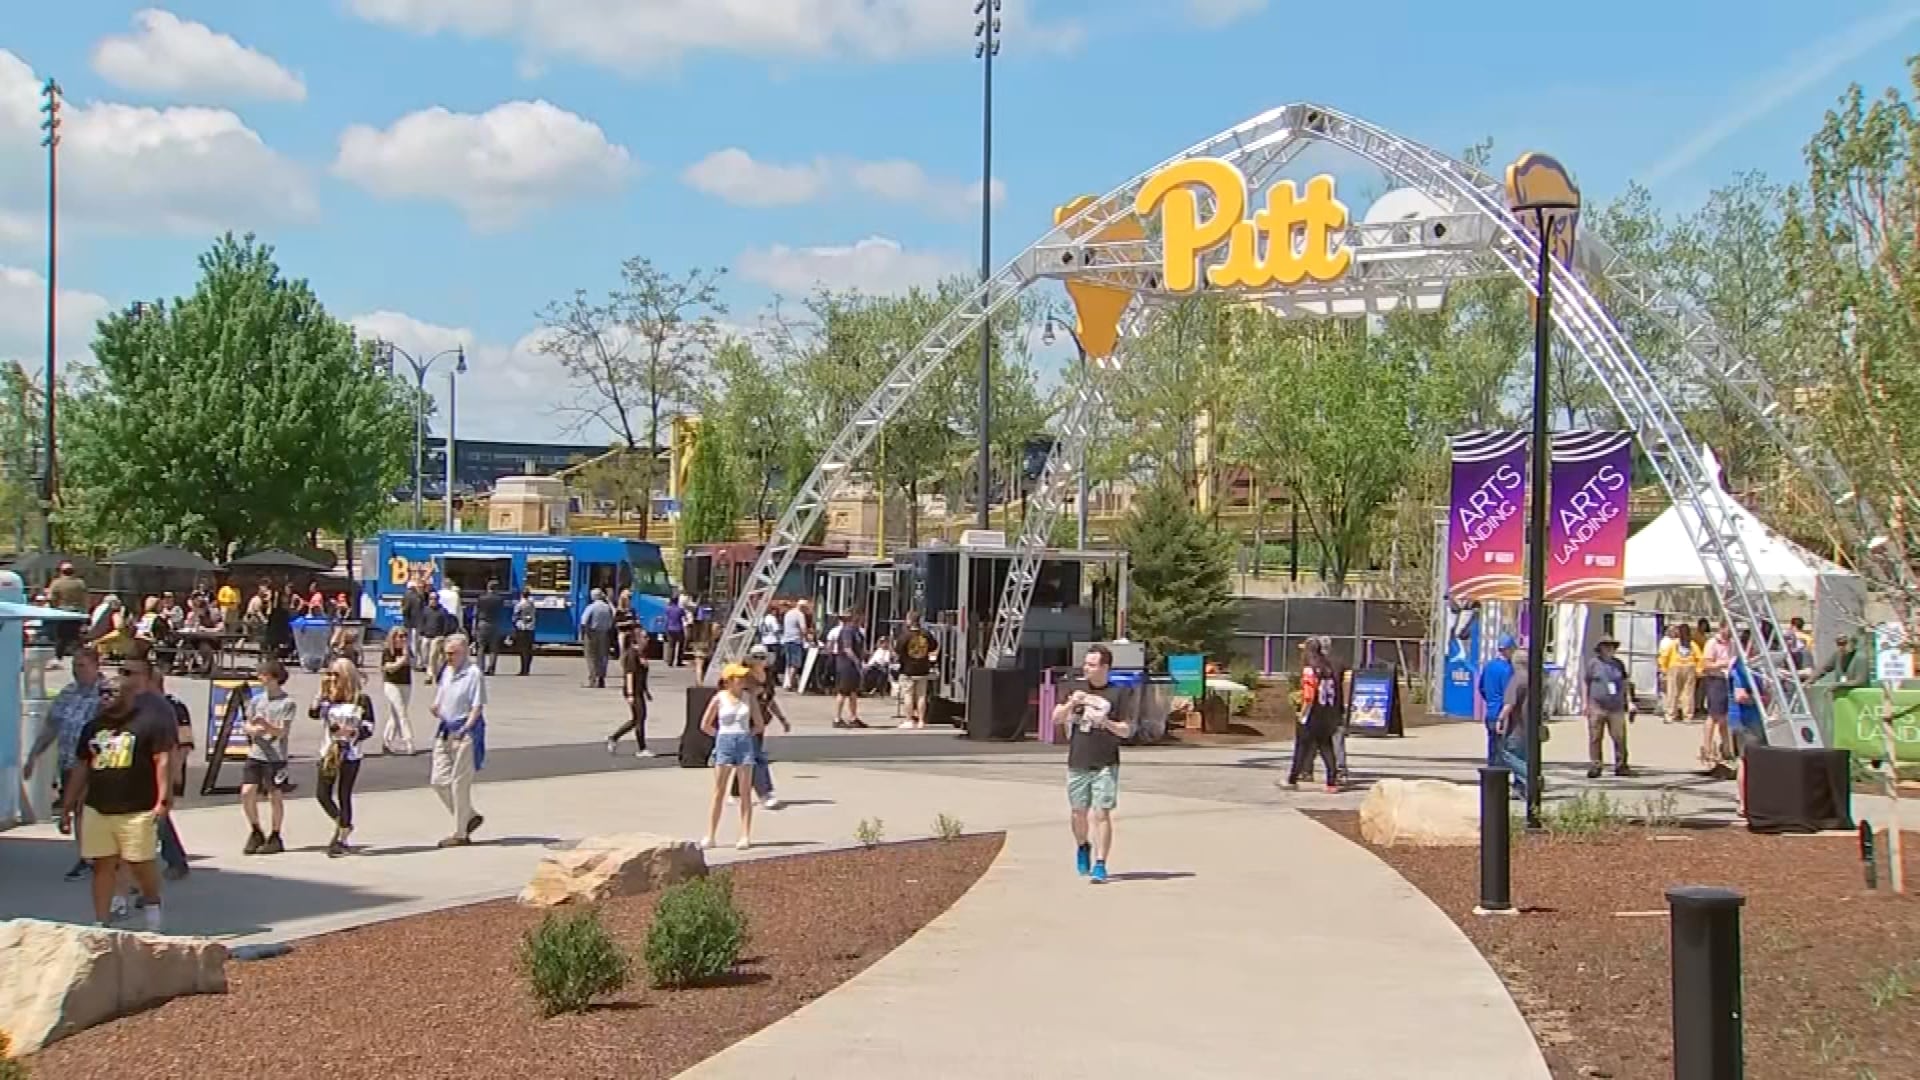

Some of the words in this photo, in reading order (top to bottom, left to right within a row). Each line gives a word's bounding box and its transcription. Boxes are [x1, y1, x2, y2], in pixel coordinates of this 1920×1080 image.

[1135, 157, 1354, 292] Pitt
[1454, 500, 1517, 563] LANDING
[1459, 464, 1522, 533] ARTS
[1553, 501, 1619, 565] LANDING
[1559, 465, 1625, 535] ARTS
